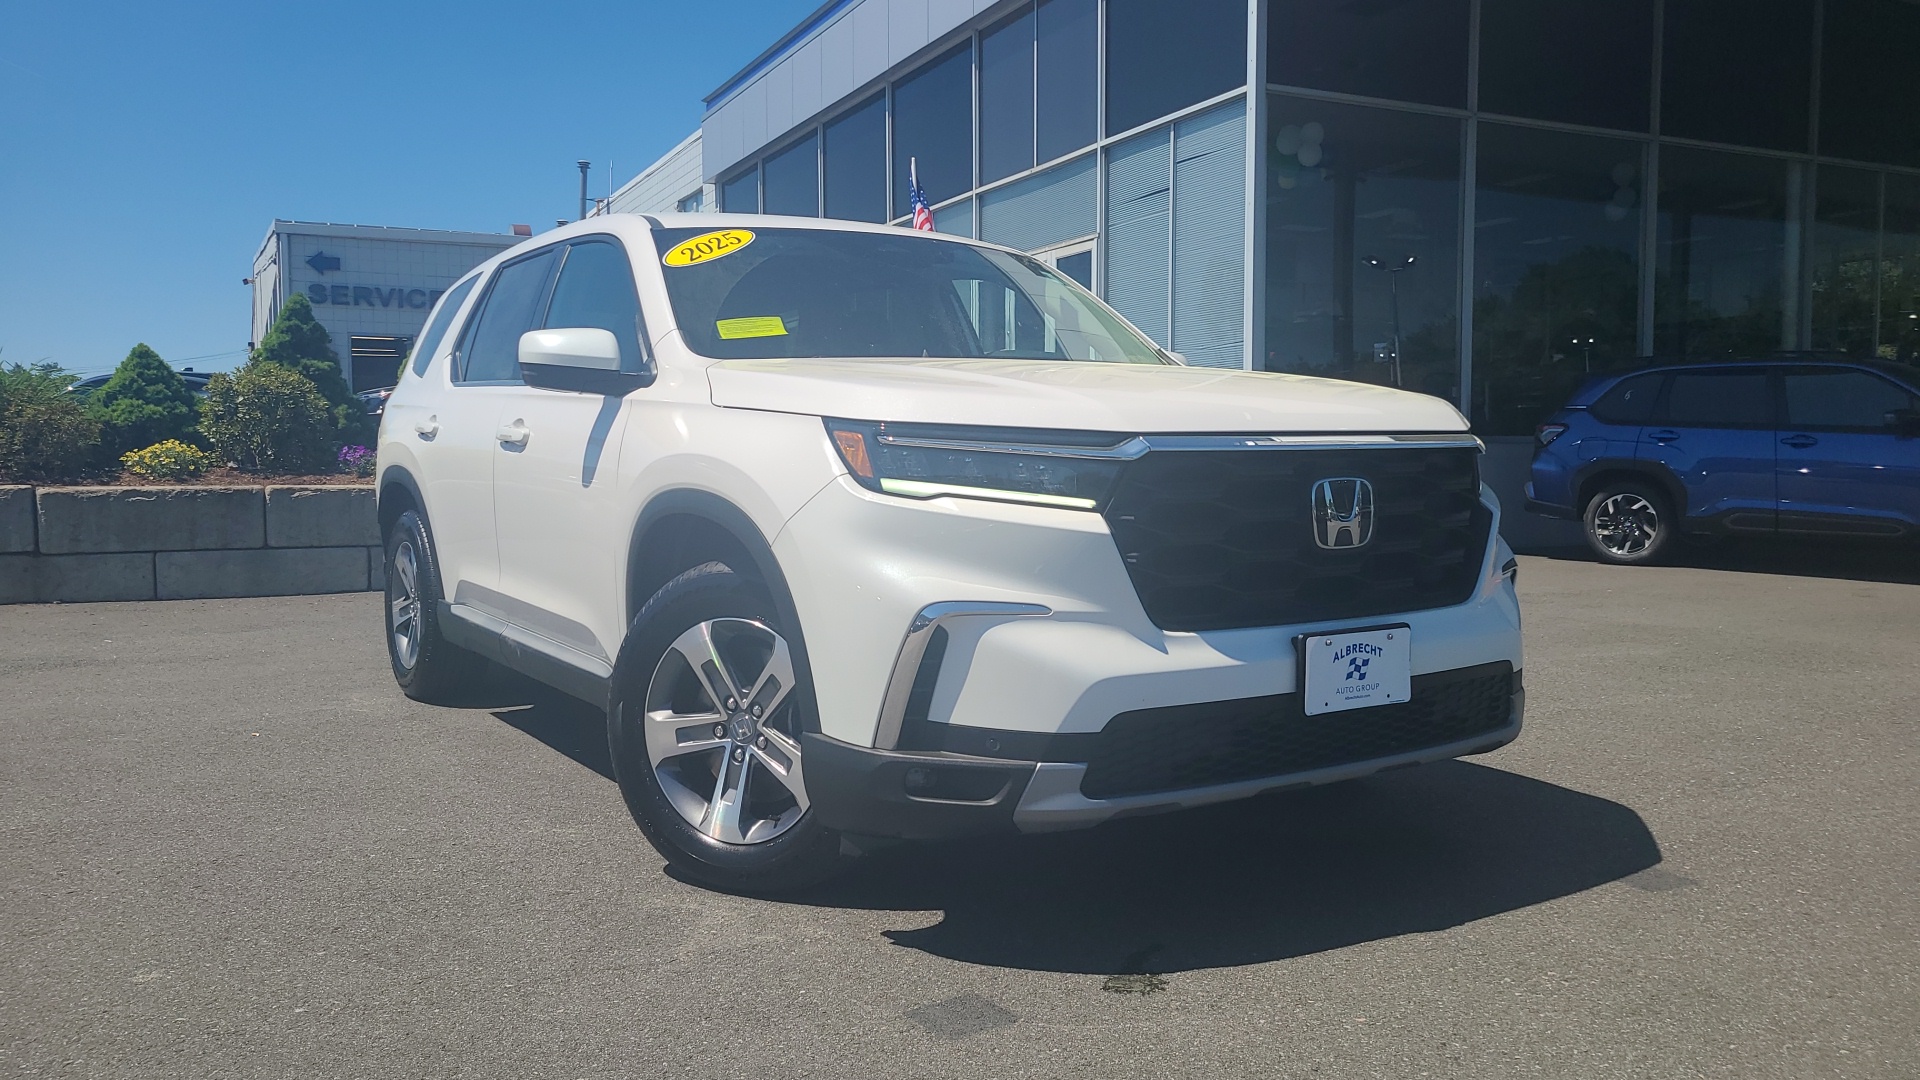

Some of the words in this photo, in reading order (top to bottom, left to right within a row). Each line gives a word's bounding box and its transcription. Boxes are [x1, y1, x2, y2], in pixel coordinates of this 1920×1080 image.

[681, 233, 741, 261] 2025
[1332, 643, 1383, 663] ALBRECHT
[1336, 686, 1354, 695] AUTO
[1356, 682, 1380, 692] GROUP
